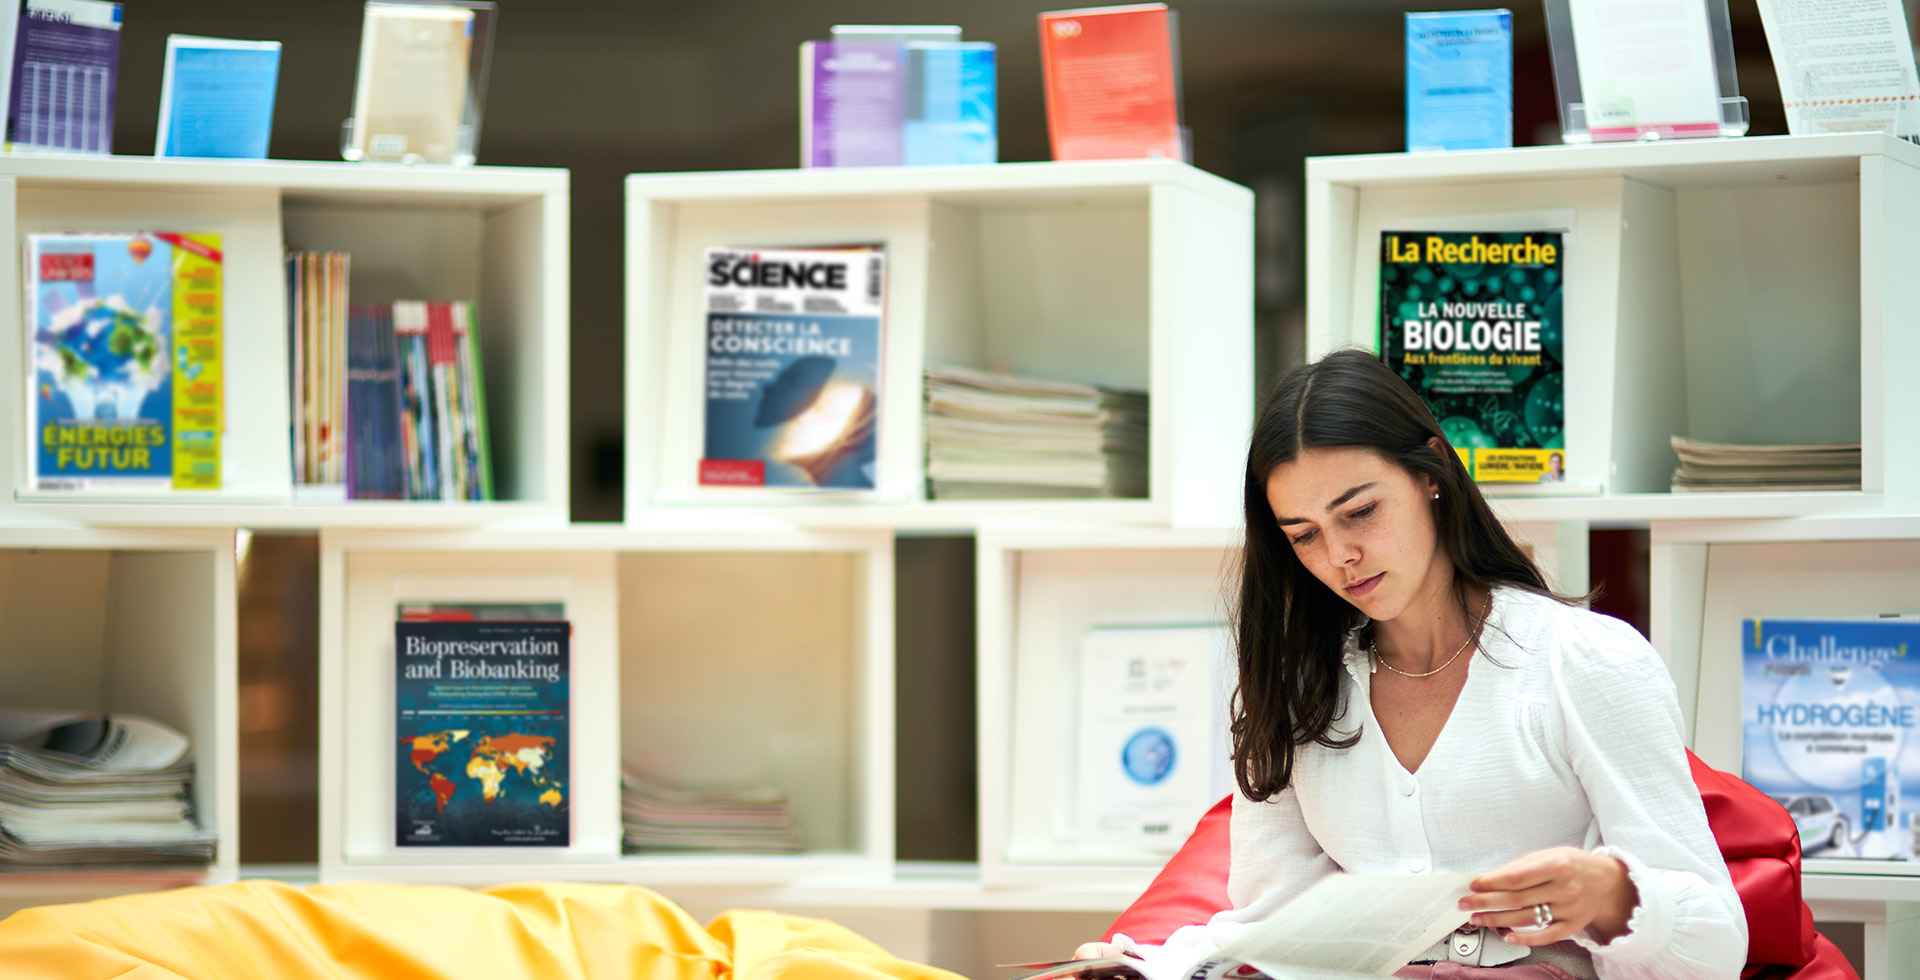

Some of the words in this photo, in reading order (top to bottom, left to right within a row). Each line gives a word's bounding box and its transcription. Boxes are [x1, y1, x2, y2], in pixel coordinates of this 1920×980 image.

[1392, 236, 1420, 263] La
[1426, 236, 1556, 264] Recherche
[710, 255, 847, 290] SCIENCE
[1418, 303, 1439, 318] LA
[1443, 303, 1525, 319] NOUVELLE
[711, 318, 795, 335] DÉTECTER
[800, 322, 822, 336] LA
[1404, 320, 1542, 351] BIOLOGIE
[711, 335, 851, 357] CONSCIENCE
[1404, 352, 1426, 365] Aux
[1428, 352, 1486, 366] frontières
[1489, 353, 1504, 366] du
[1506, 353, 1542, 366] vivant
[43, 420, 165, 446] ÉNERGIES
[58, 448, 151, 471] FUTUR
[405, 636, 560, 660] Biopreservation
[1766, 635, 1908, 669] Challenges
[405, 659, 441, 679] and
[450, 659, 560, 683] Biobanking
[1757, 699, 1915, 728] HYDROGÈNE
